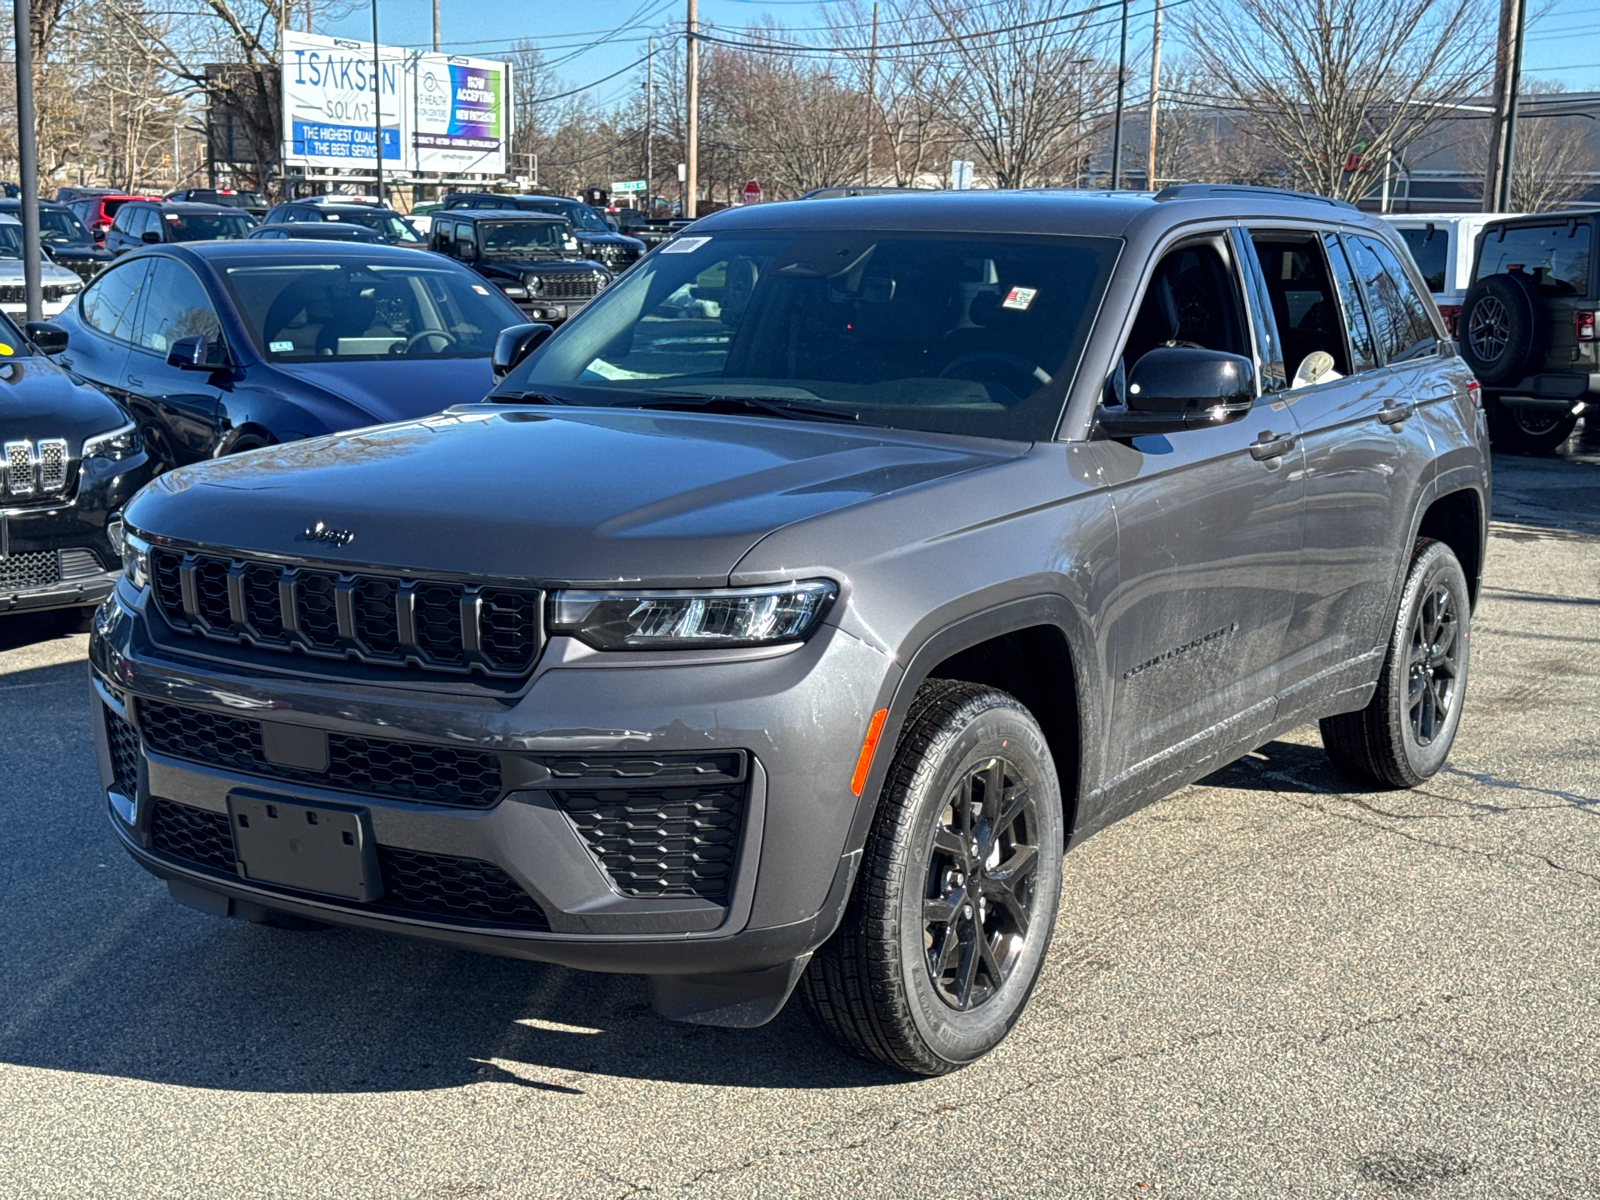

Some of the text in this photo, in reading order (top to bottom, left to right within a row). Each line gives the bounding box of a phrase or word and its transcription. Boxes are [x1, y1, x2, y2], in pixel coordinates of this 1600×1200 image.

[456, 87, 496, 104] ACCEPTING
[326, 99, 369, 122] SOLAR
[302, 125, 320, 140] THE
[320, 127, 353, 142] HIGHEST
[353, 129, 384, 144] QUALI
[313, 141, 378, 158] THE BEST SERVIC
[303, 520, 354, 548] Jeep
